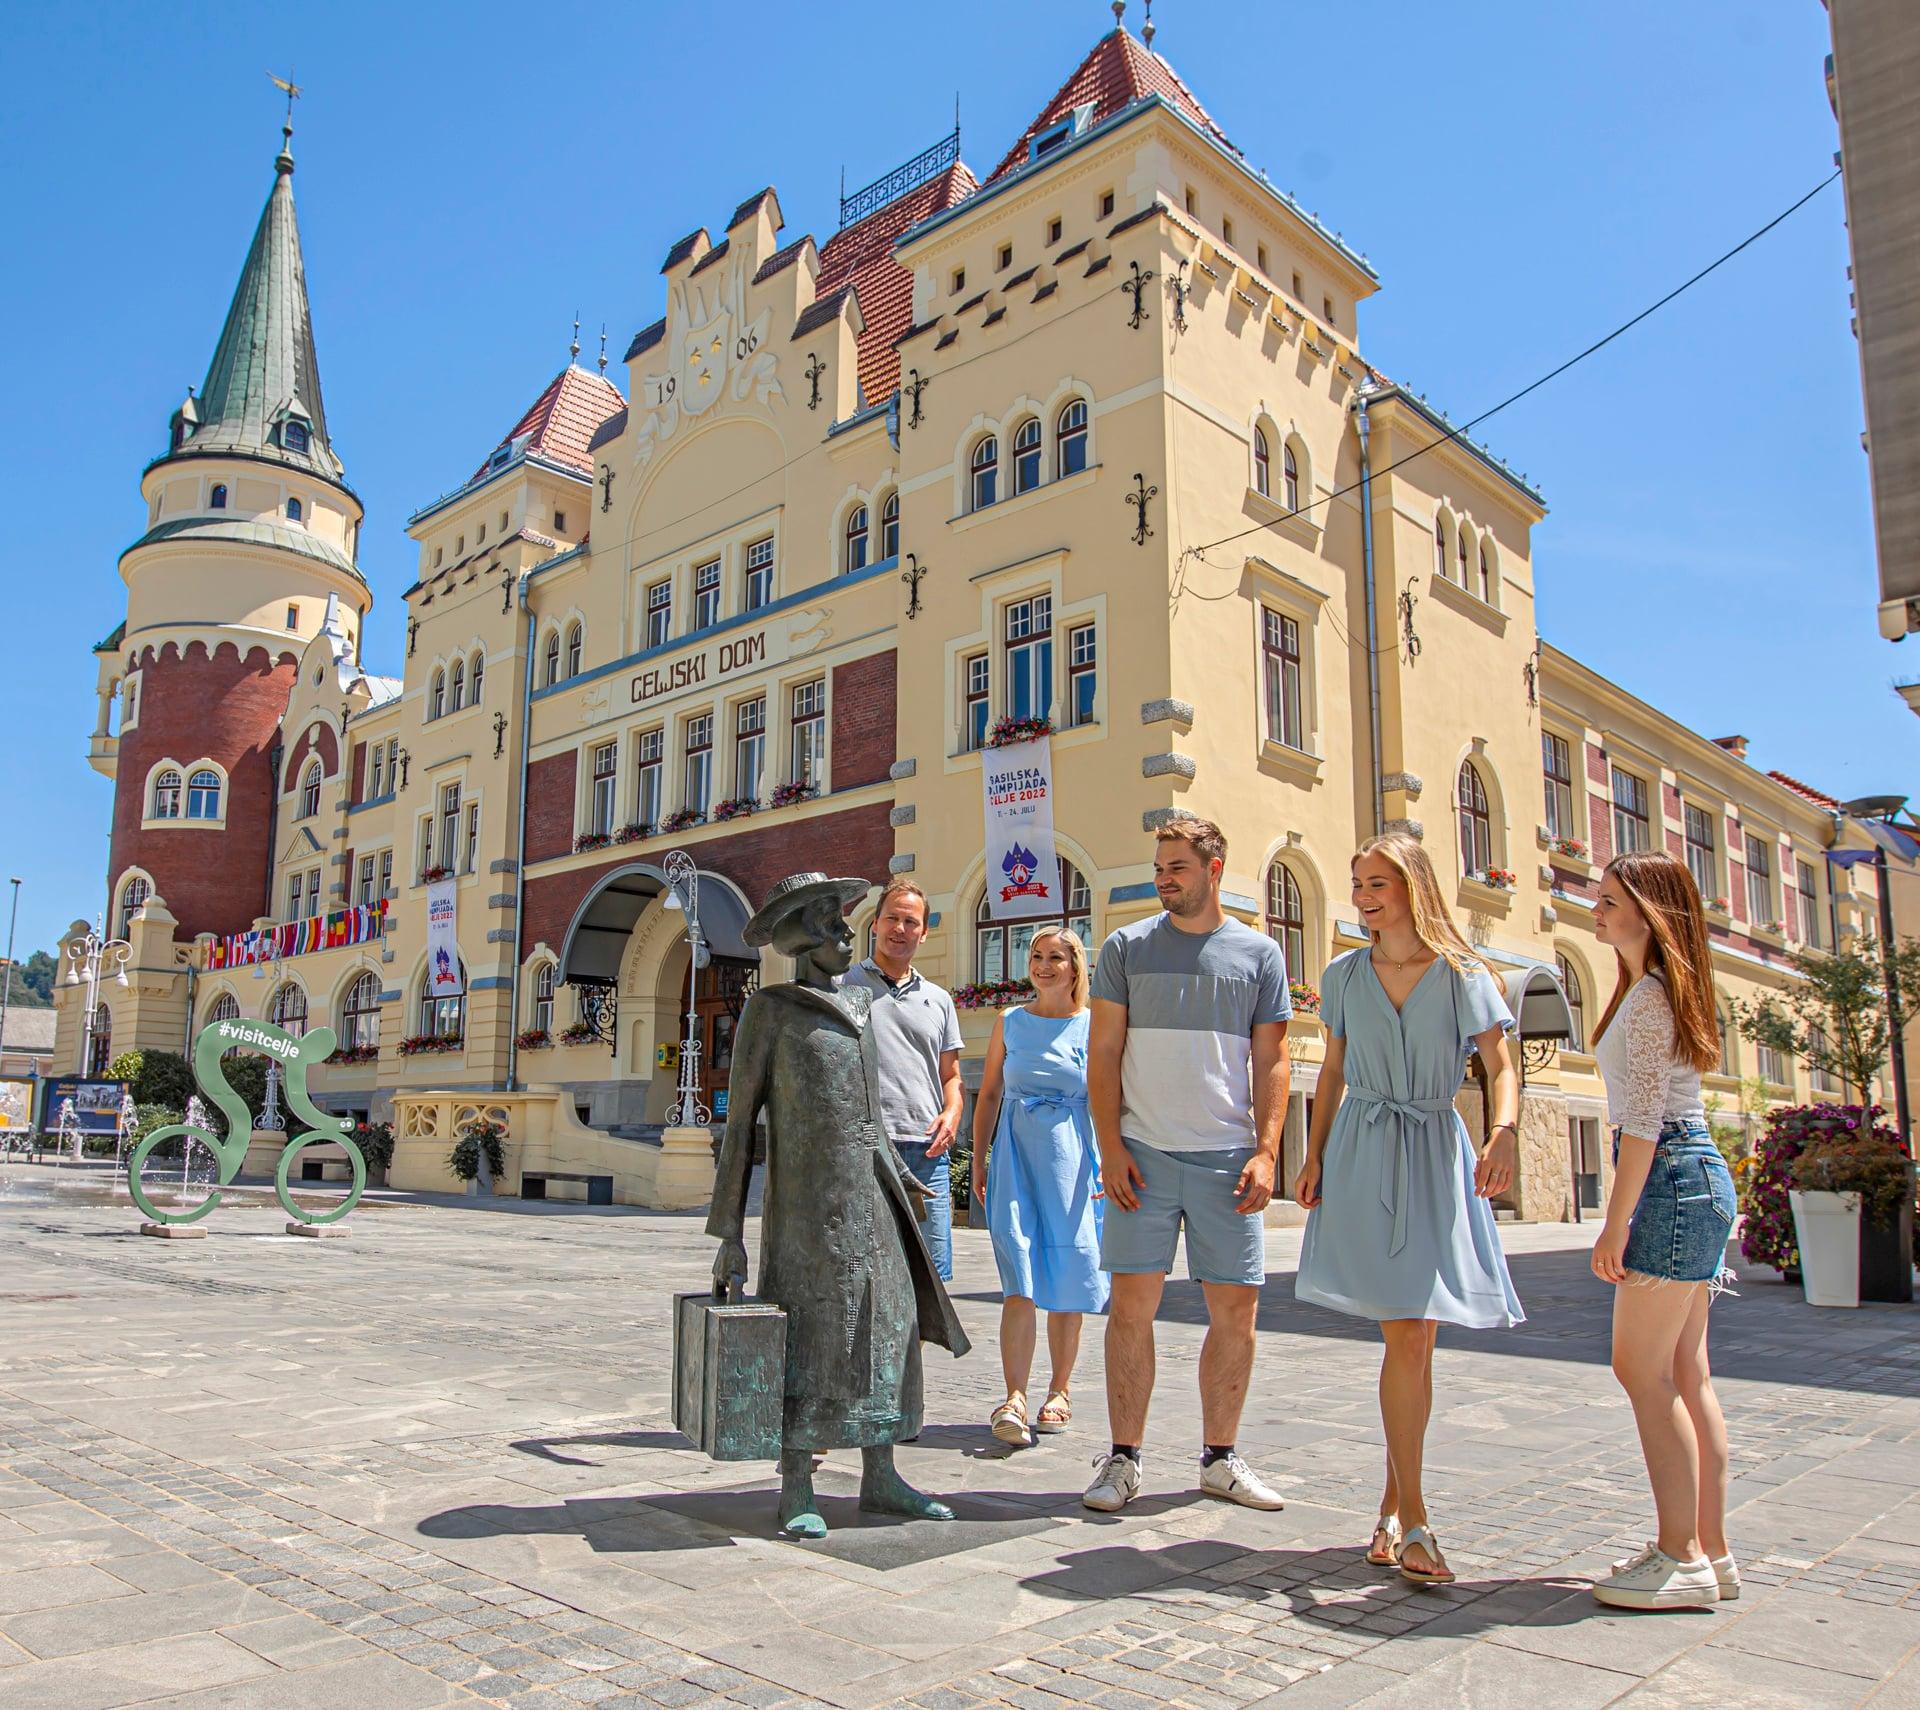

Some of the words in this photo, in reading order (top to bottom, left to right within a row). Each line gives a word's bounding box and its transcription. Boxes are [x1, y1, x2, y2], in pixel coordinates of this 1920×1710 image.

[657, 377, 676, 405] 19
[736, 327, 758, 361] 06
[631, 653, 707, 703] CELJSKI
[718, 631, 766, 674] DOM
[988, 777, 1047, 796] IMPIJADA
[1019, 787, 1046, 801] 2022
[219, 1022, 299, 1058] #visitcelje
